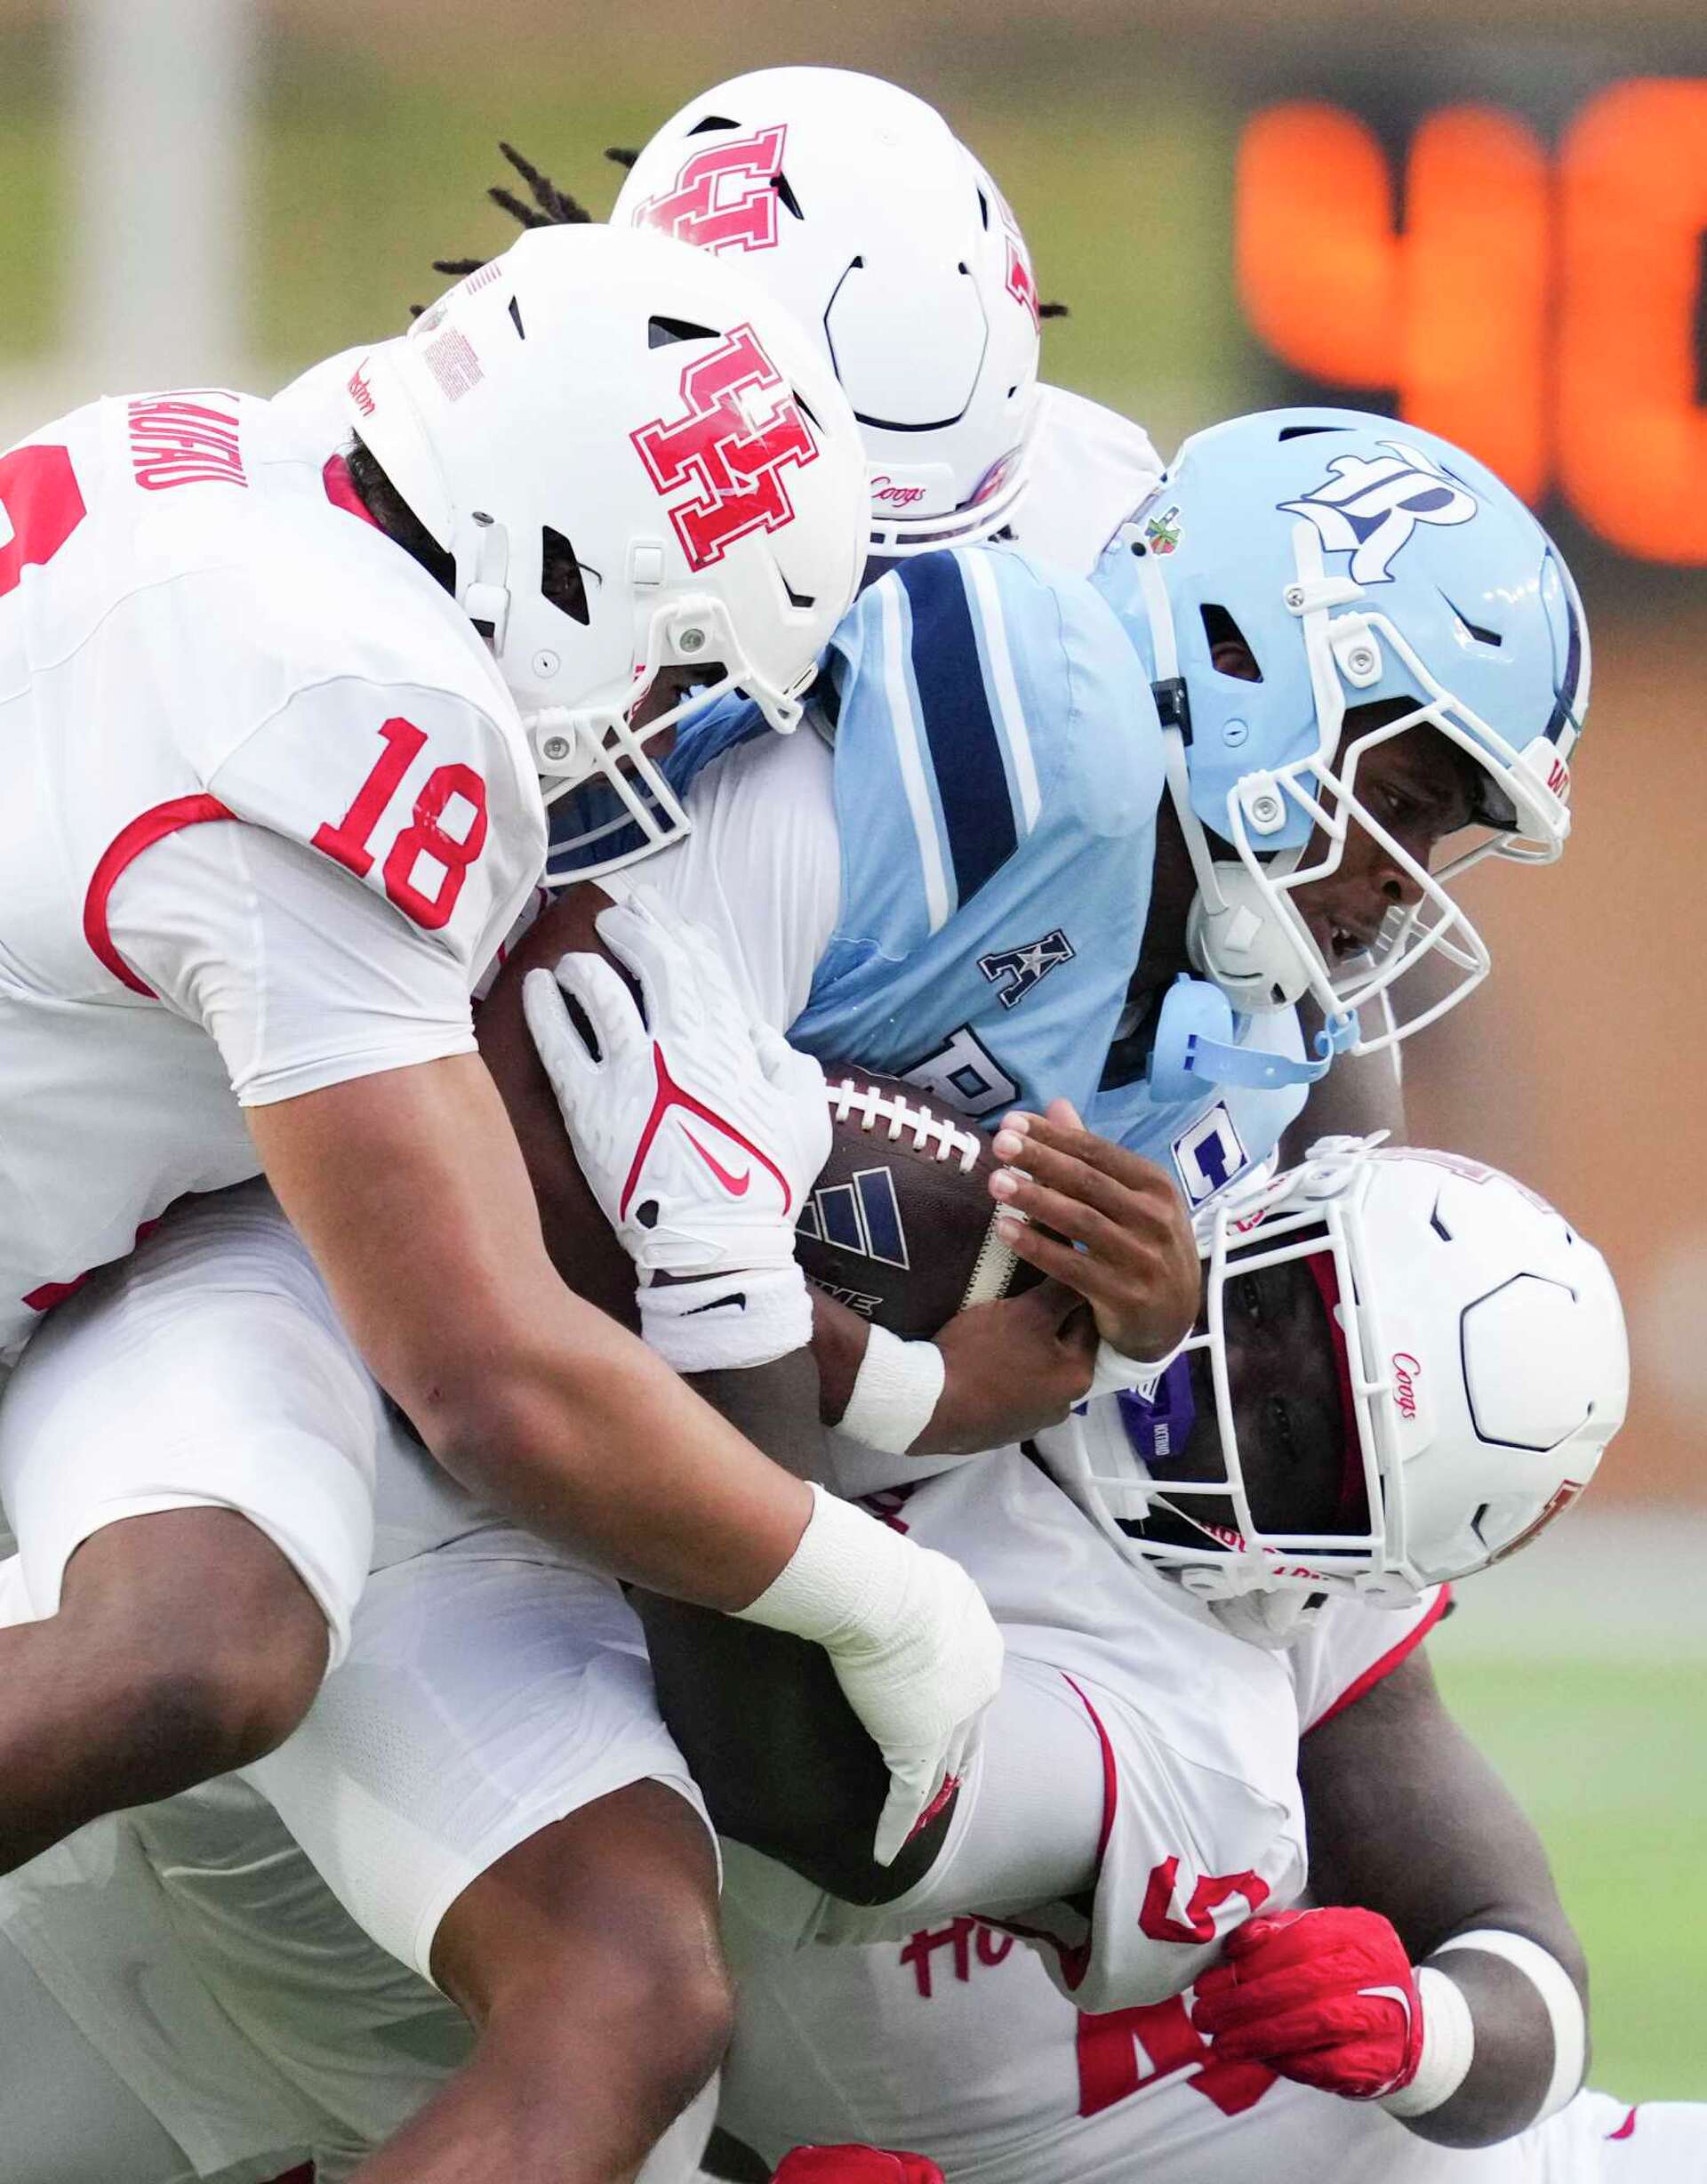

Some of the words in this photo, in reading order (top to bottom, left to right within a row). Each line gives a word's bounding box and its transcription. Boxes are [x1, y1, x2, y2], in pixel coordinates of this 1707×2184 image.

[310, 717, 488, 930] 18
[976, 928, 1076, 1010] A
[1392, 1353, 1421, 1419] Coogs
